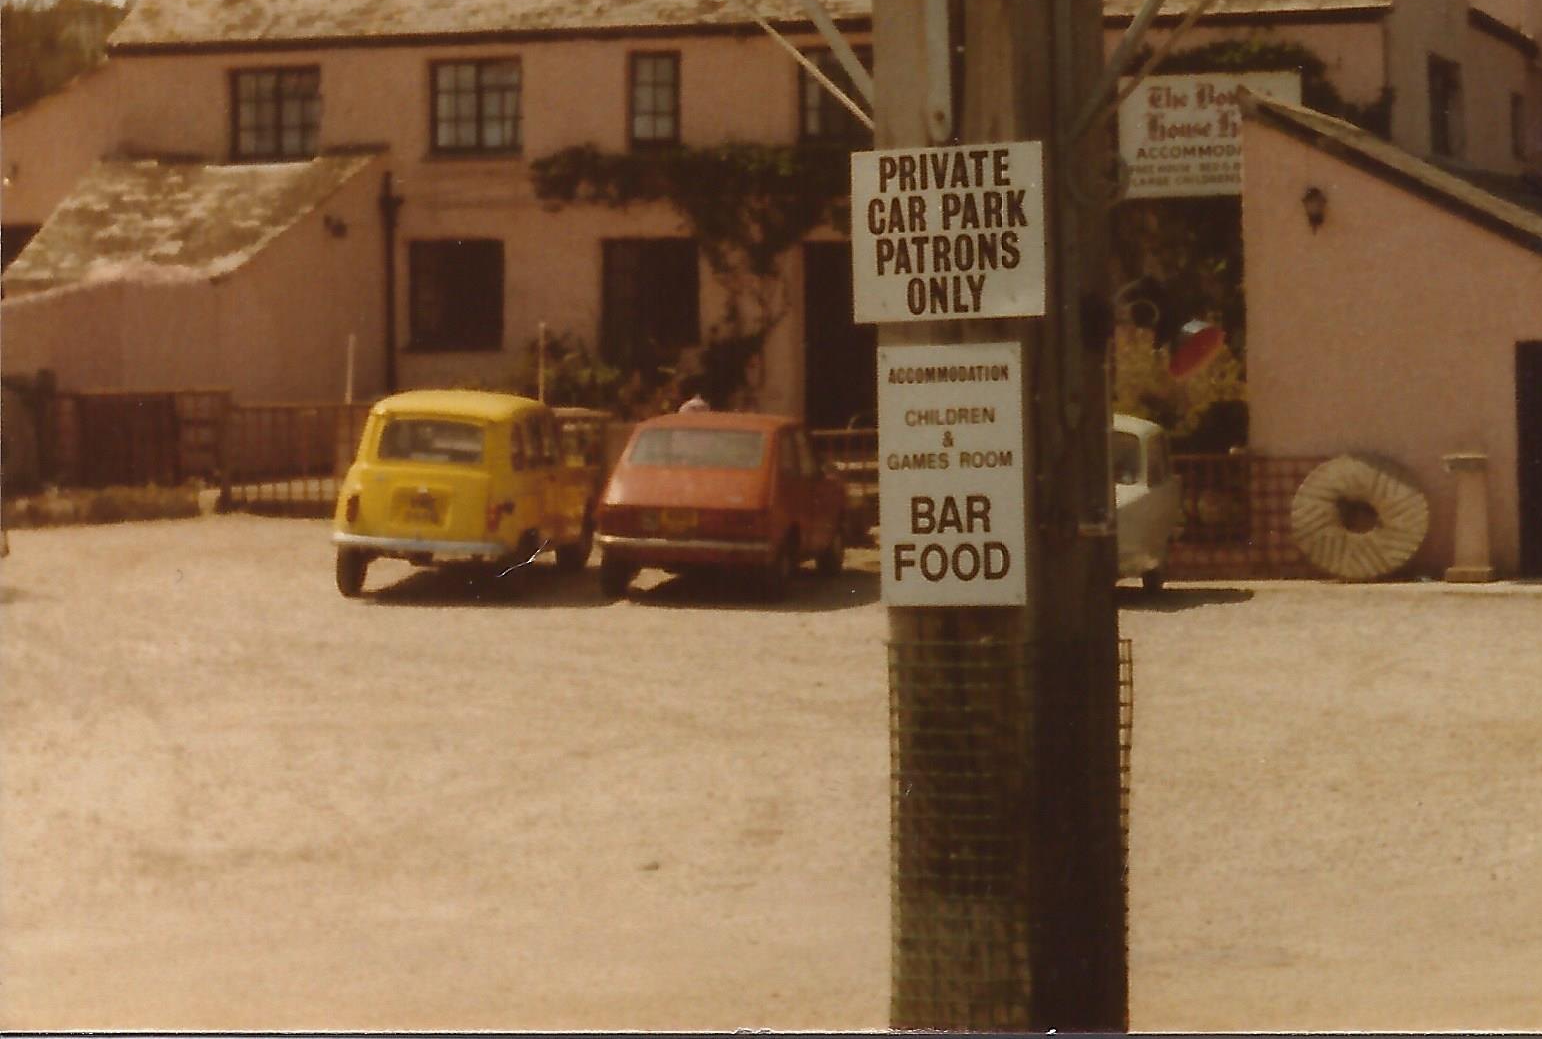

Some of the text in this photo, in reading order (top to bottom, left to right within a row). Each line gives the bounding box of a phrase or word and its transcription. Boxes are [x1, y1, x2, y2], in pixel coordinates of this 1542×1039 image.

[878, 148, 1011, 194] PRIVATE
[867, 189, 1028, 235] CAR PARK
[876, 230, 1021, 276] PATRONS
[907, 274, 986, 315] ONLY
[888, 364, 1009, 385] ACCOMMODATION
[904, 407, 996, 426] CHILDREN
[942, 431, 954, 448] &
[887, 450, 1013, 471] GAMES ROOM
[910, 494, 992, 535] BAR
[893, 541, 1011, 582] FOOD
